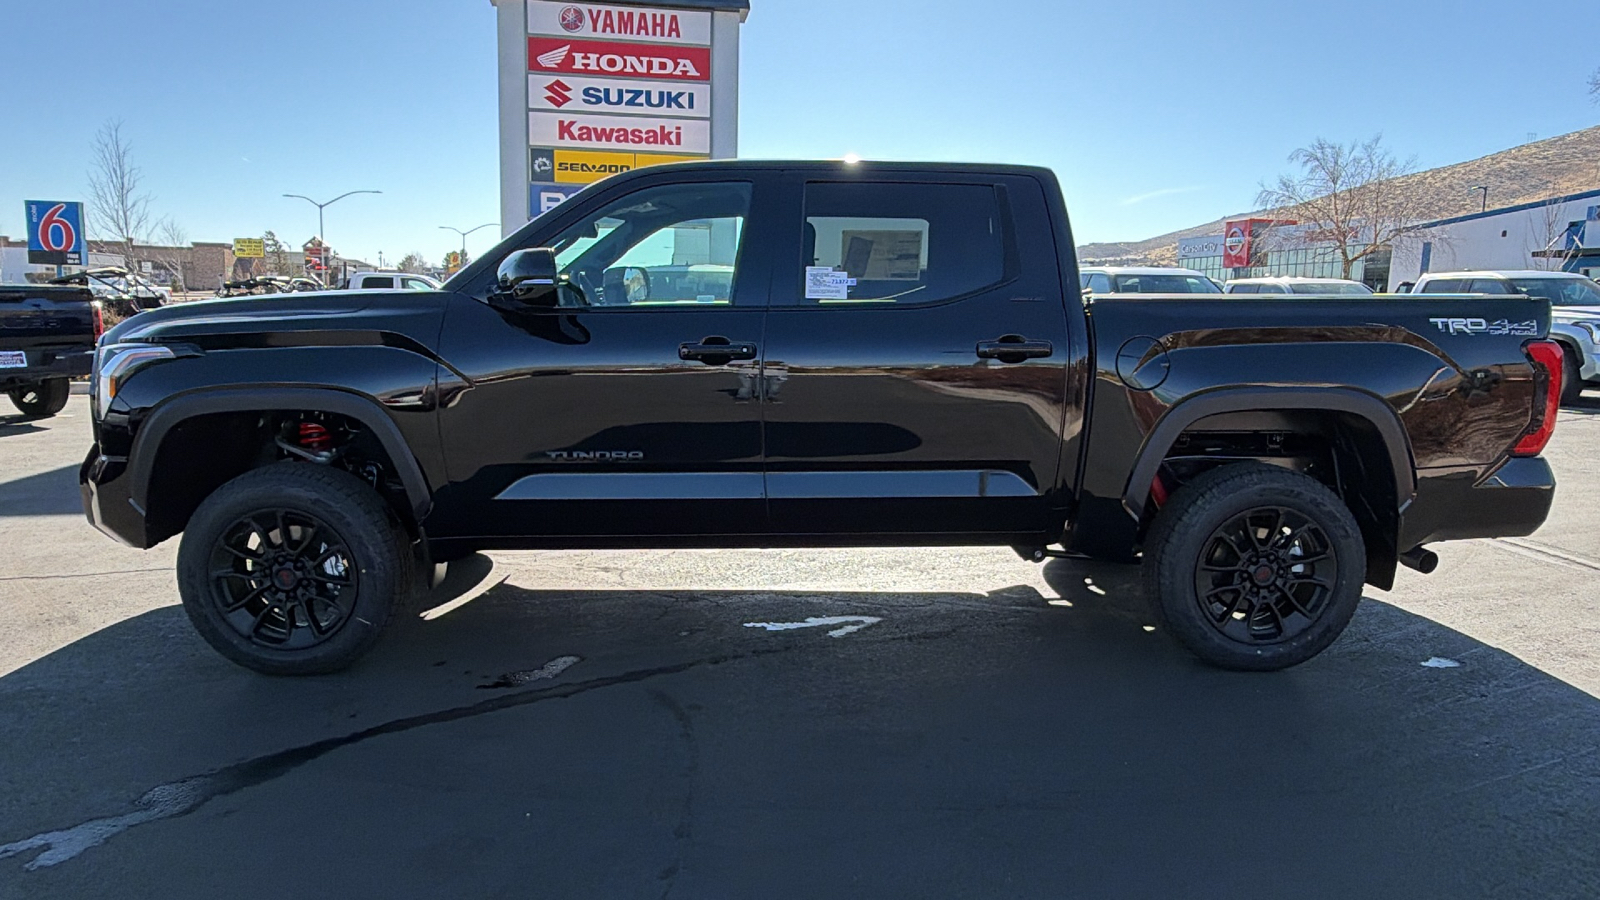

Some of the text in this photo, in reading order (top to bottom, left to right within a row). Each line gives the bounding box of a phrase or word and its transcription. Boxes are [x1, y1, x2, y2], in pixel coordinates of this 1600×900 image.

[587, 8, 681, 38] YAMAHA
[571, 52, 700, 77] HONDA
[581, 86, 694, 110] SUZUKI
[557, 119, 682, 146] Kawasaki
[38, 203, 75, 252] 6
[1181, 242, 1218, 253] Carson City
[1429, 318, 1488, 335] TRD
[545, 450, 644, 459] TUNDRA
